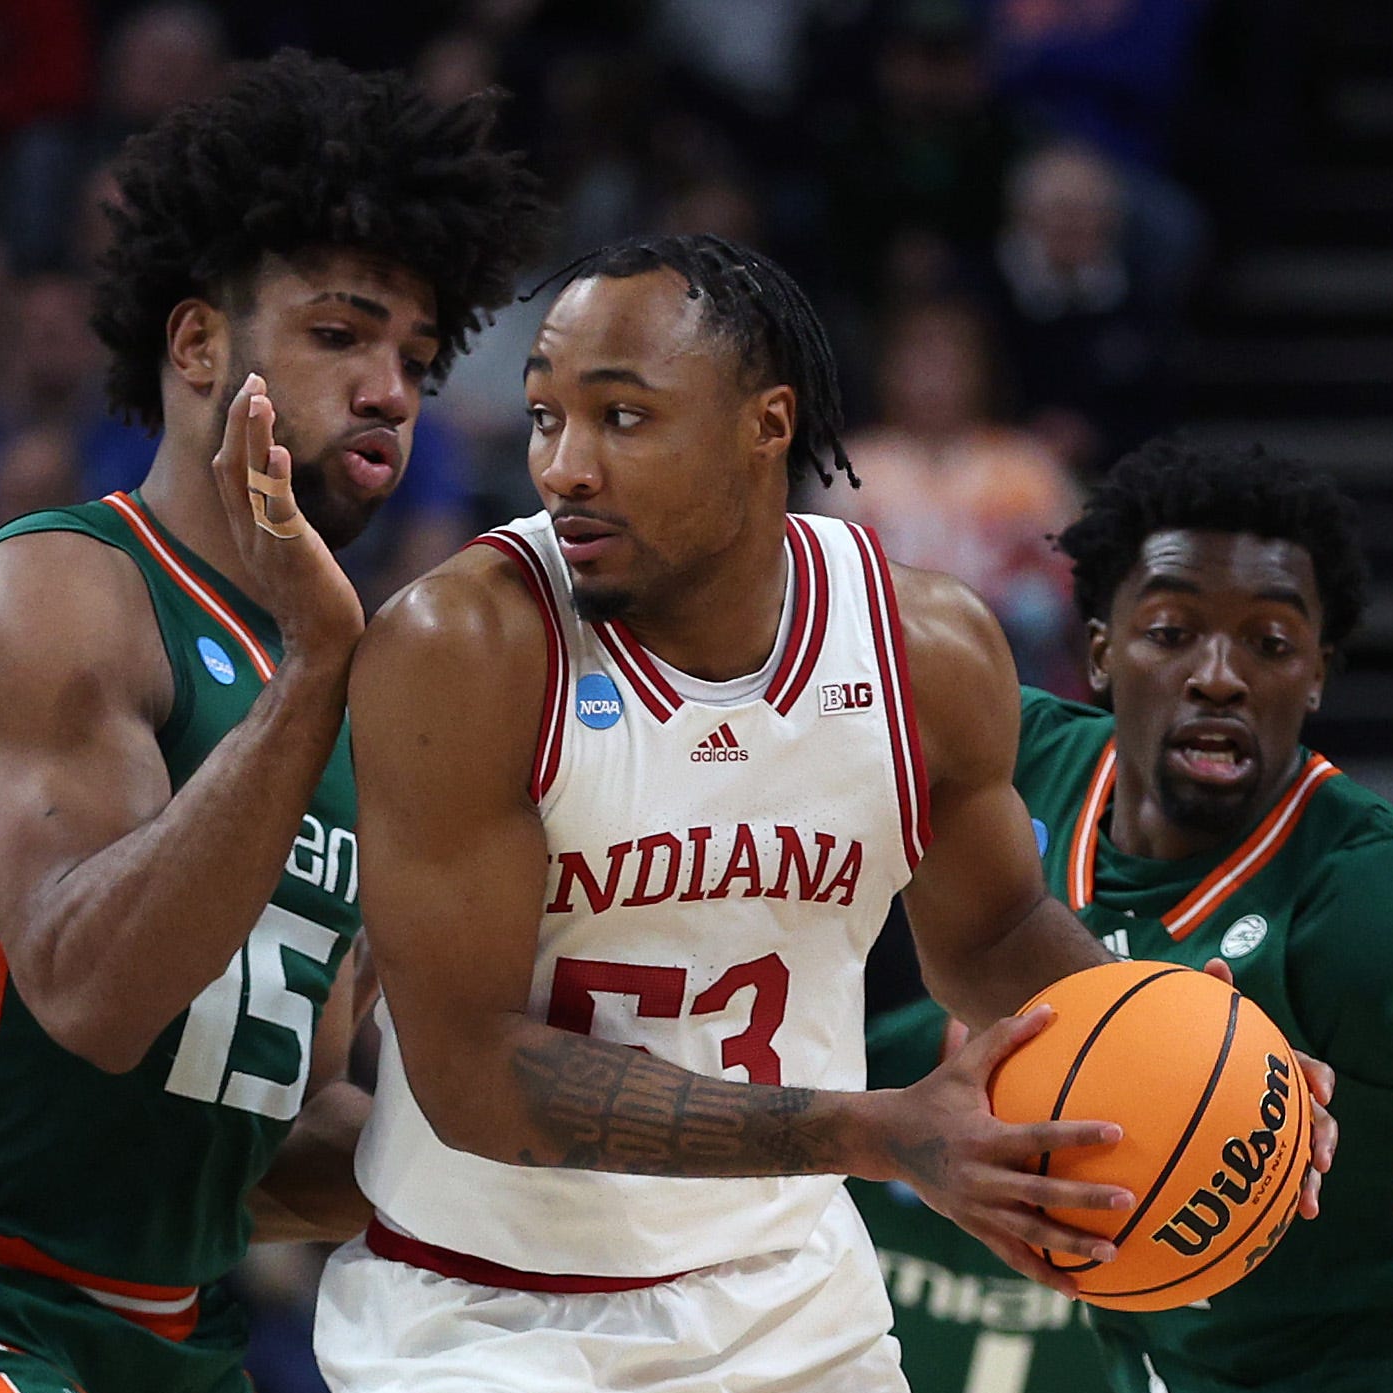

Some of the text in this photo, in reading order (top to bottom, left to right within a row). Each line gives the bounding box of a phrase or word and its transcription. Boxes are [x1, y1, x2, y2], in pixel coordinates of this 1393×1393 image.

[579, 699, 621, 716] NCAA
[690, 747, 749, 763] adidas
[545, 823, 863, 915] NDIANA
[164, 903, 341, 1122] 15
[1150, 1052, 1292, 1258] Wilson
